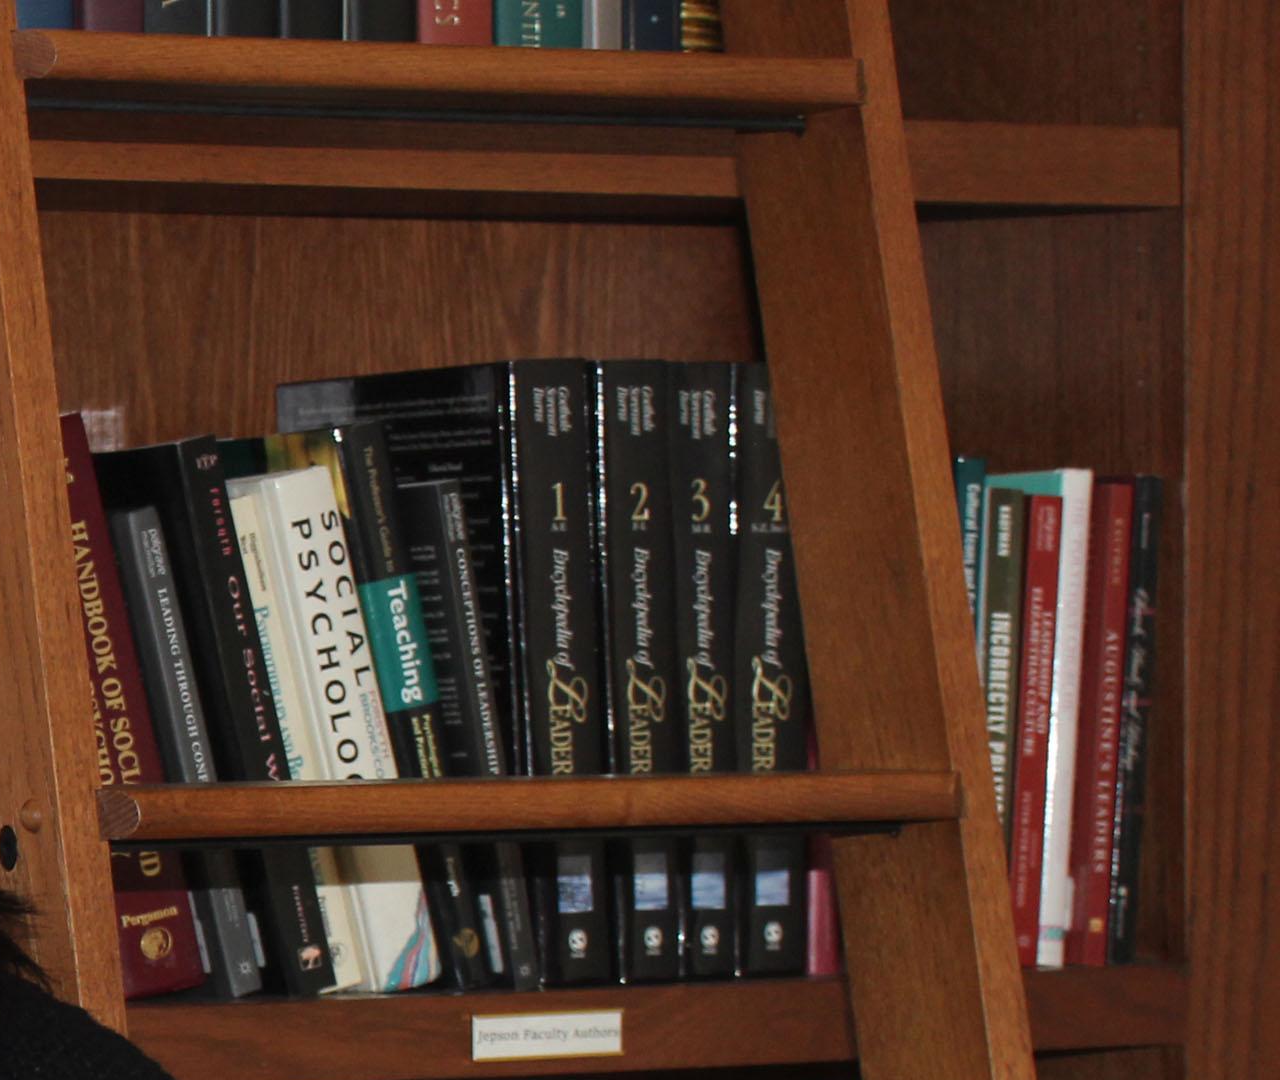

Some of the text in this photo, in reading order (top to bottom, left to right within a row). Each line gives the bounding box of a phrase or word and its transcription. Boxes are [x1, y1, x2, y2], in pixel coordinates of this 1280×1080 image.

[551, 482, 567, 520] 1
[630, 482, 650, 520] 2
[691, 479, 710, 522] 3
[763, 479, 782, 522] 4
[71, 520, 116, 674] HANDBOOK
[101, 677, 126, 711] OF
[291, 517, 363, 783] PSYCHOLO
[321, 510, 371, 687] SOCIAL
[387, 580, 422, 704] Teaching
[546, 659, 588, 775] LEADER
[986, 612, 1011, 735] INCORRECTLY
[478, 1026, 619, 1045] Jepson Faculty Authors
